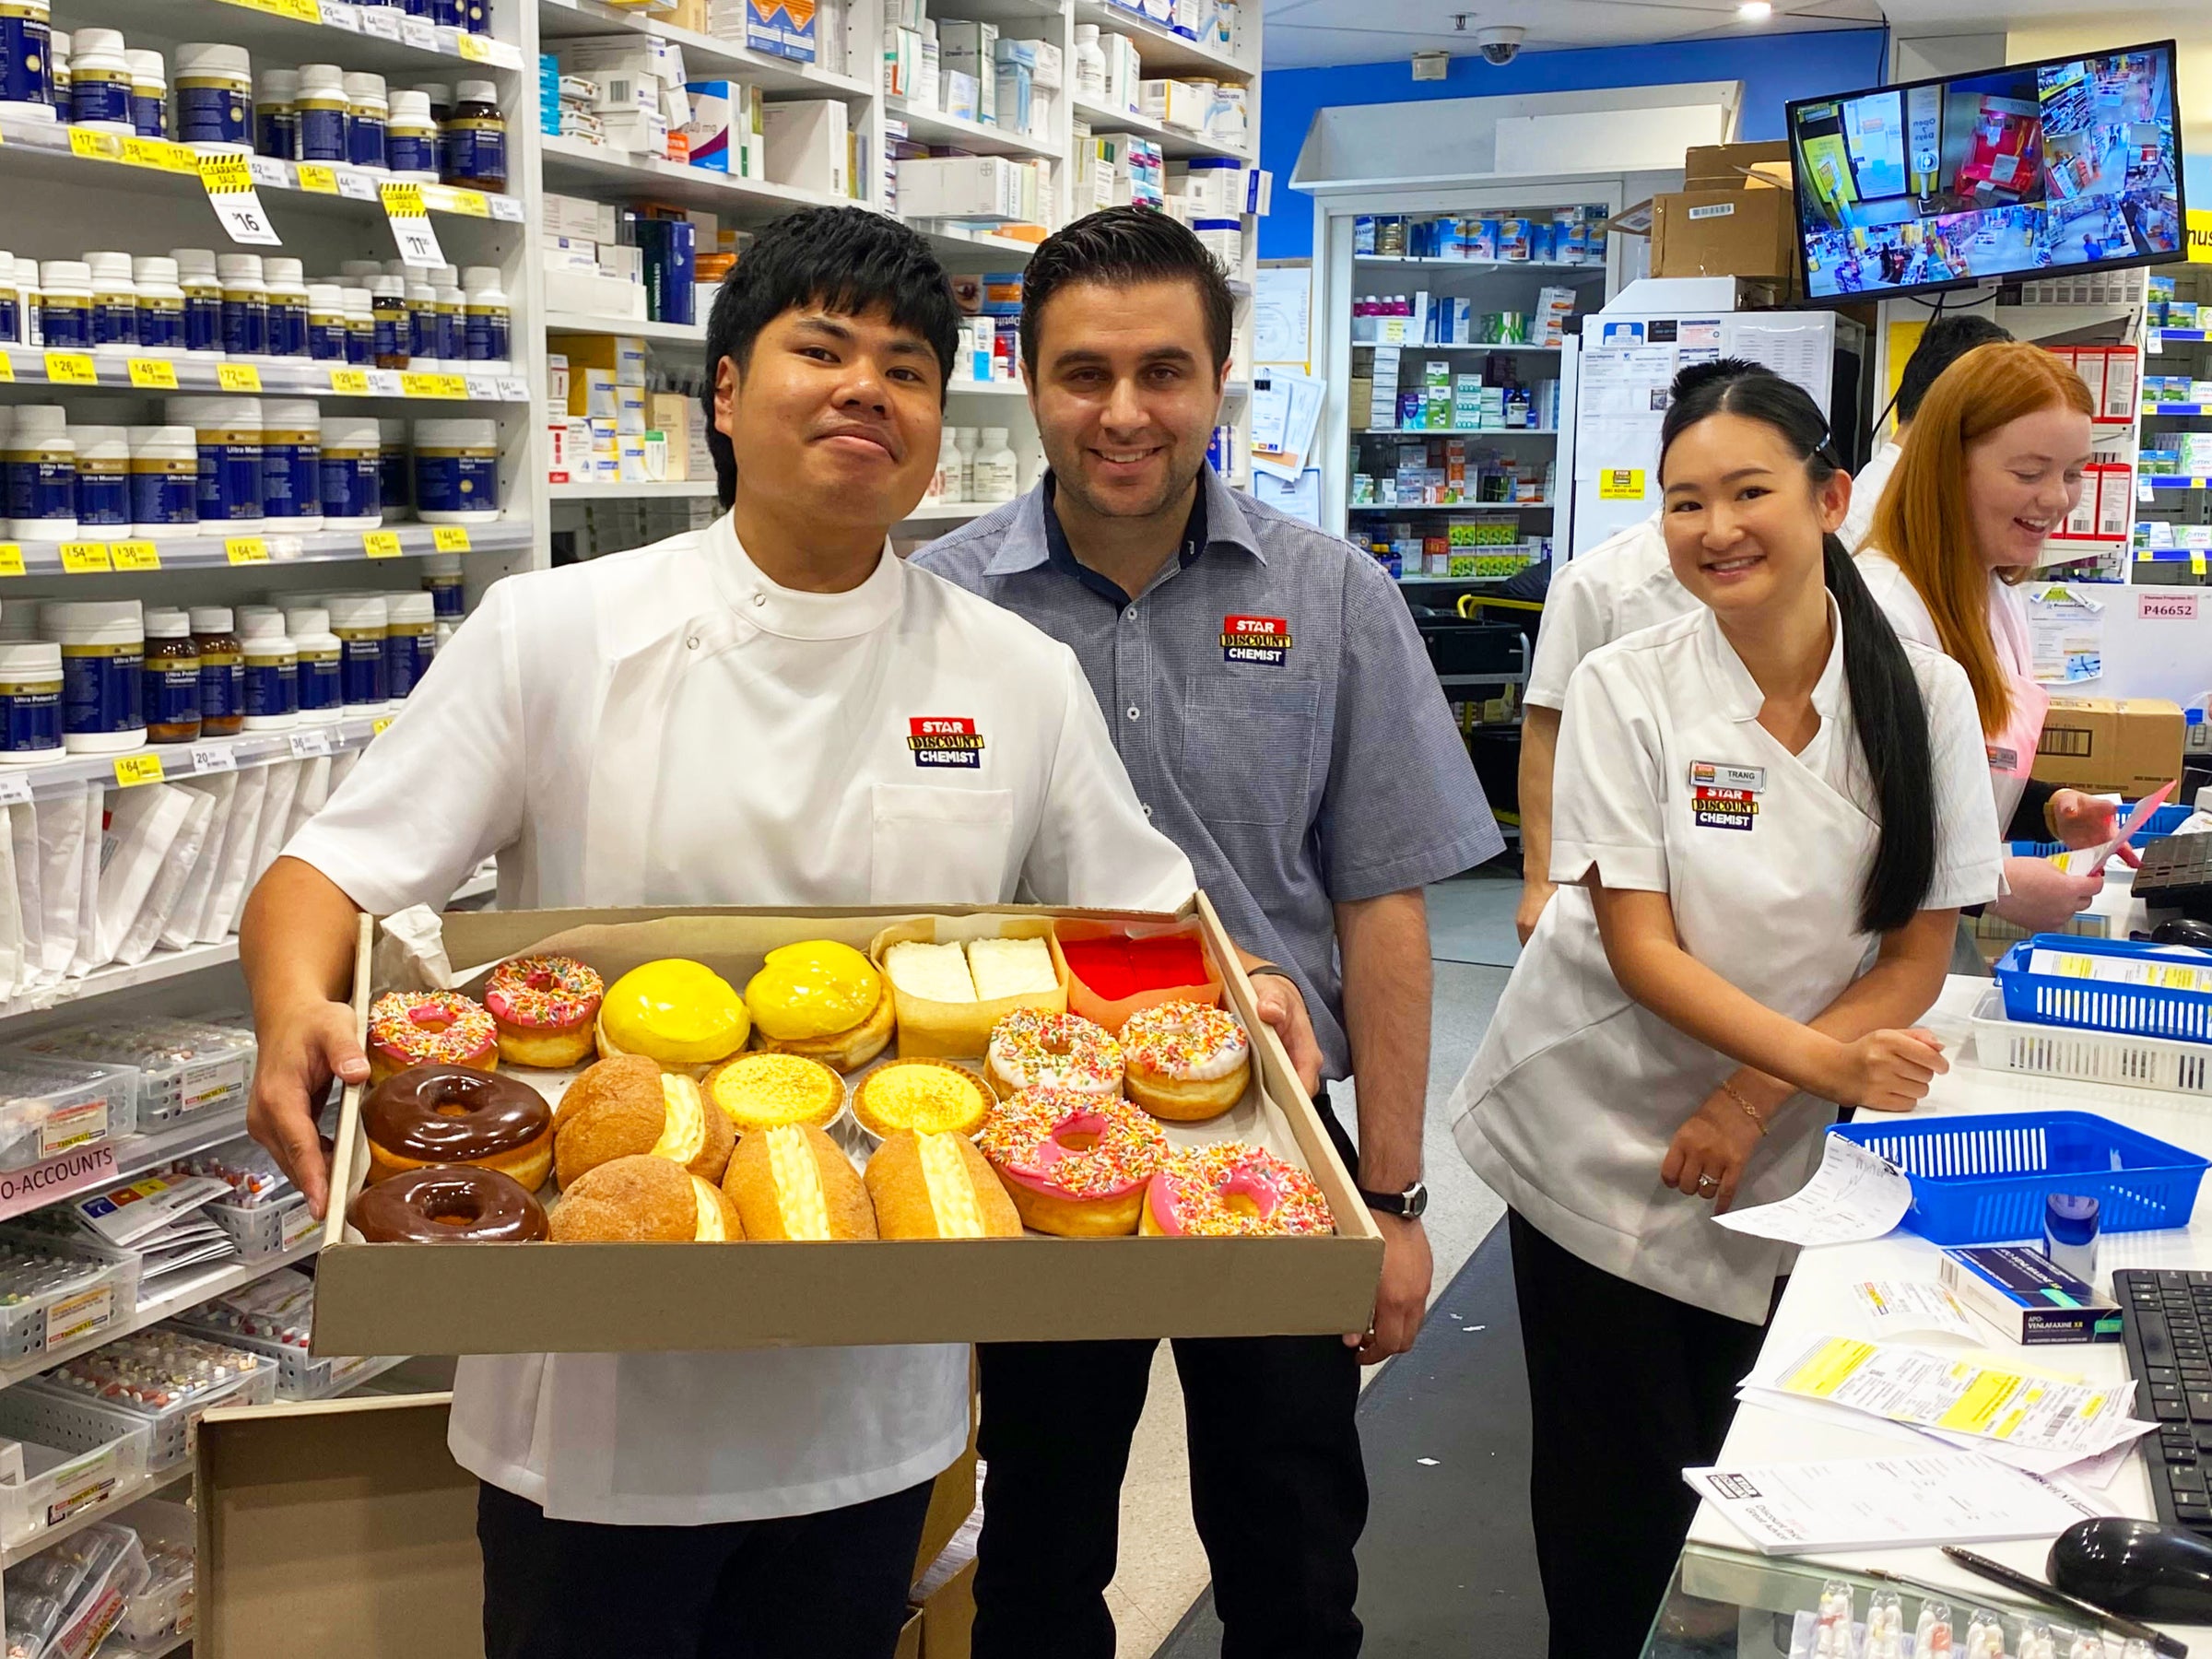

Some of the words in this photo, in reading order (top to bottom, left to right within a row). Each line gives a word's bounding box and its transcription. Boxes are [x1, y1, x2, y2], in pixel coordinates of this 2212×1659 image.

[2144, 606, 2192, 615] P46652
[1236, 620, 1275, 633] STAR
[1225, 634, 1288, 647] DISCOUNT
[1229, 648, 1282, 662] CHEMIST
[923, 721, 964, 734] STAR
[912, 735, 980, 748] DISCOUNT
[919, 751, 975, 763] CHEMIST
[1727, 771, 1755, 780] TRANG
[1707, 788, 1743, 799] STAR
[1697, 799, 1755, 812] DISCOUNT
[1700, 812, 1749, 827] CHEMIST
[1, 1147, 112, 1199] O-ACCOUNTS
